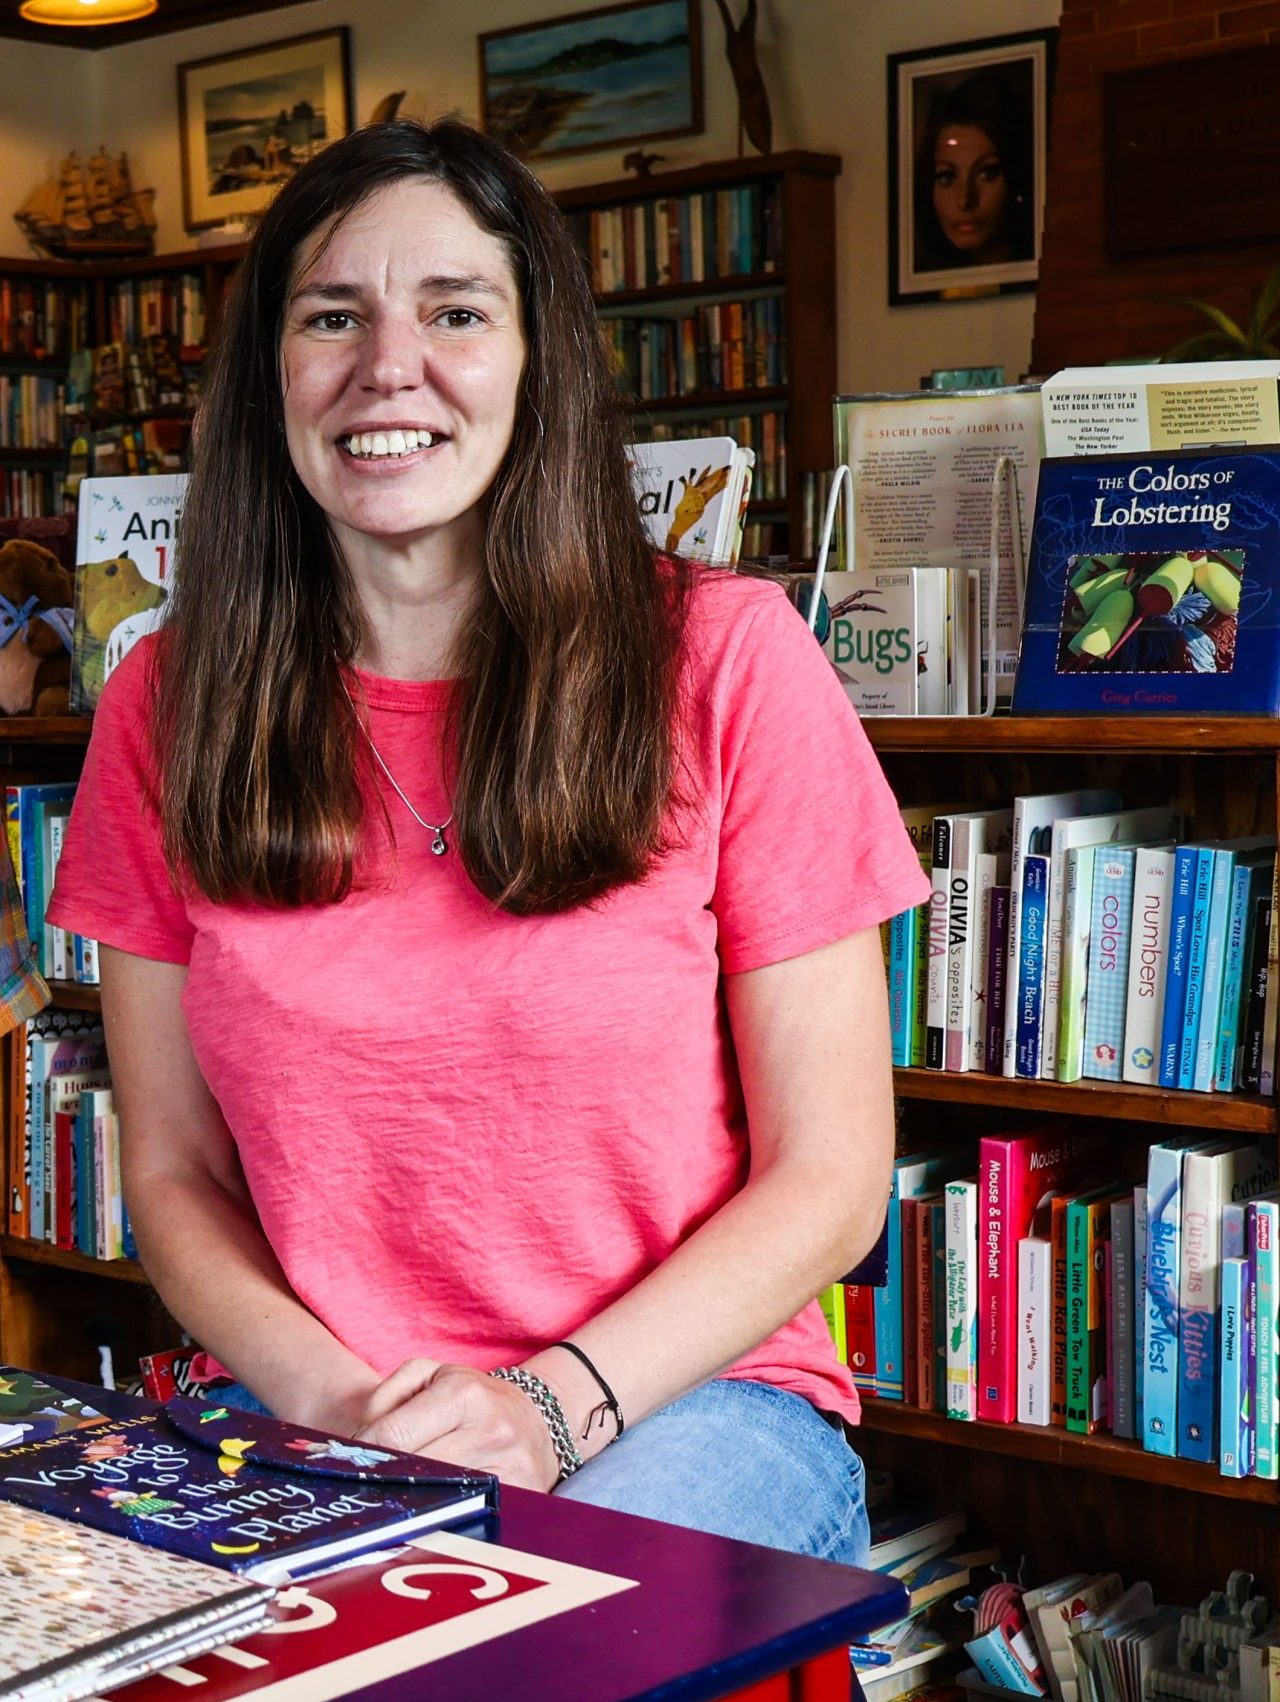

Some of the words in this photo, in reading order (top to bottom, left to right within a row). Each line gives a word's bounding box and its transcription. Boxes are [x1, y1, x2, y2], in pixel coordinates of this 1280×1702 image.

[1053, 403, 1070, 411] BEST
[1072, 403, 1090, 411] BOOK
[1092, 402, 1101, 410] OF
[1102, 402, 1115, 410] THE
[1117, 402, 1136, 410] YEAR
[1055, 393, 1071, 401] NEW
[1073, 393, 1090, 401] YORK
[1091, 393, 1112, 401] TIMES
[880, 427, 917, 438] SECRET
[922, 426, 952, 436] BOOK
[966, 424, 1000, 434] FLORA
[1005, 422, 1025, 432] LEA
[1093, 426, 1111, 434] Today
[1097, 477, 1125, 490] THE
[1128, 466, 1210, 493] Colors
[1213, 471, 1235, 484] OF
[122, 509, 182, 541] Ani
[1091, 495, 1232, 531] Lobstering
[833, 619, 912, 674] Bugs
[937, 824, 948, 862] Falconer
[1066, 858, 1077, 895] Animals
[1180, 858, 1191, 877] Eric
[1200, 859, 1210, 879] Eric
[1178, 877, 1189, 896] Hill
[1197, 881, 1208, 900] Hill
[928, 890, 948, 957] OLIVIA
[1010, 891, 1018, 936] CORDUROY'S
[1027, 906, 1041, 940] Good
[1193, 909, 1205, 932] Spot
[1050, 916, 1062, 945] TIME
[1099, 895, 1123, 971] colors
[1175, 915, 1187, 949] Where's
[1025, 943, 1041, 981] Night
[1049, 949, 1061, 967] for
[1138, 895, 1163, 998] numbers
[1192, 934, 1203, 963] Loves
[1171, 950, 1183, 976] Spot?
[1190, 965, 1200, 982] His
[929, 965, 944, 1004] counts
[949, 961, 964, 1025] opposites
[1048, 980, 1060, 1004] HUG
[1024, 985, 1037, 1025] Beach
[1185, 983, 1199, 1027] Grandpa
[1164, 1043, 1176, 1080] WARNE
[1182, 1037, 1193, 1076] PUTNAM
[45, 1139, 53, 1169] Carrot
[45, 1171, 53, 1193] Seed
[988, 1160, 1001, 1204] Mouse
[988, 1206, 1001, 1217] &
[948, 1248, 957, 1261] the
[988, 1220, 1001, 1279] Elephant
[1184, 1211, 1210, 1292] Curious
[947, 1262, 958, 1299] Alligator
[956, 1260, 966, 1276] The
[1054, 1258, 1066, 1300] Little
[1071, 1262, 1083, 1293] Little
[956, 1276, 967, 1295] Lady
[947, 1300, 957, 1320] Purse
[958, 1296, 968, 1314] with
[1054, 1305, 1067, 1334] Red
[1071, 1297, 1083, 1334] Green
[1226, 1310, 1235, 1329] Love
[1181, 1303, 1210, 1381] Kitties
[1226, 1331, 1235, 1362] Puppies
[1260, 1316, 1269, 1346] TOUCH
[1054, 1341, 1067, 1386] Plane
[1072, 1339, 1083, 1362] Tow
[1149, 1326, 1172, 1374] Nest
[1260, 1347, 1268, 1355] &
[1260, 1356, 1269, 1374] FEEL
[1071, 1366, 1083, 1399] Truck
[1259, 1376, 1269, 1425] ADVENTURE
[84, 1413, 161, 1438] WELLS
[4, 1439, 188, 1490] Voyage
[138, 1468, 181, 1488] to
[178, 1475, 247, 1500] the
[145, 1482, 317, 1532] Bunny
[228, 1493, 388, 1543] Planet
